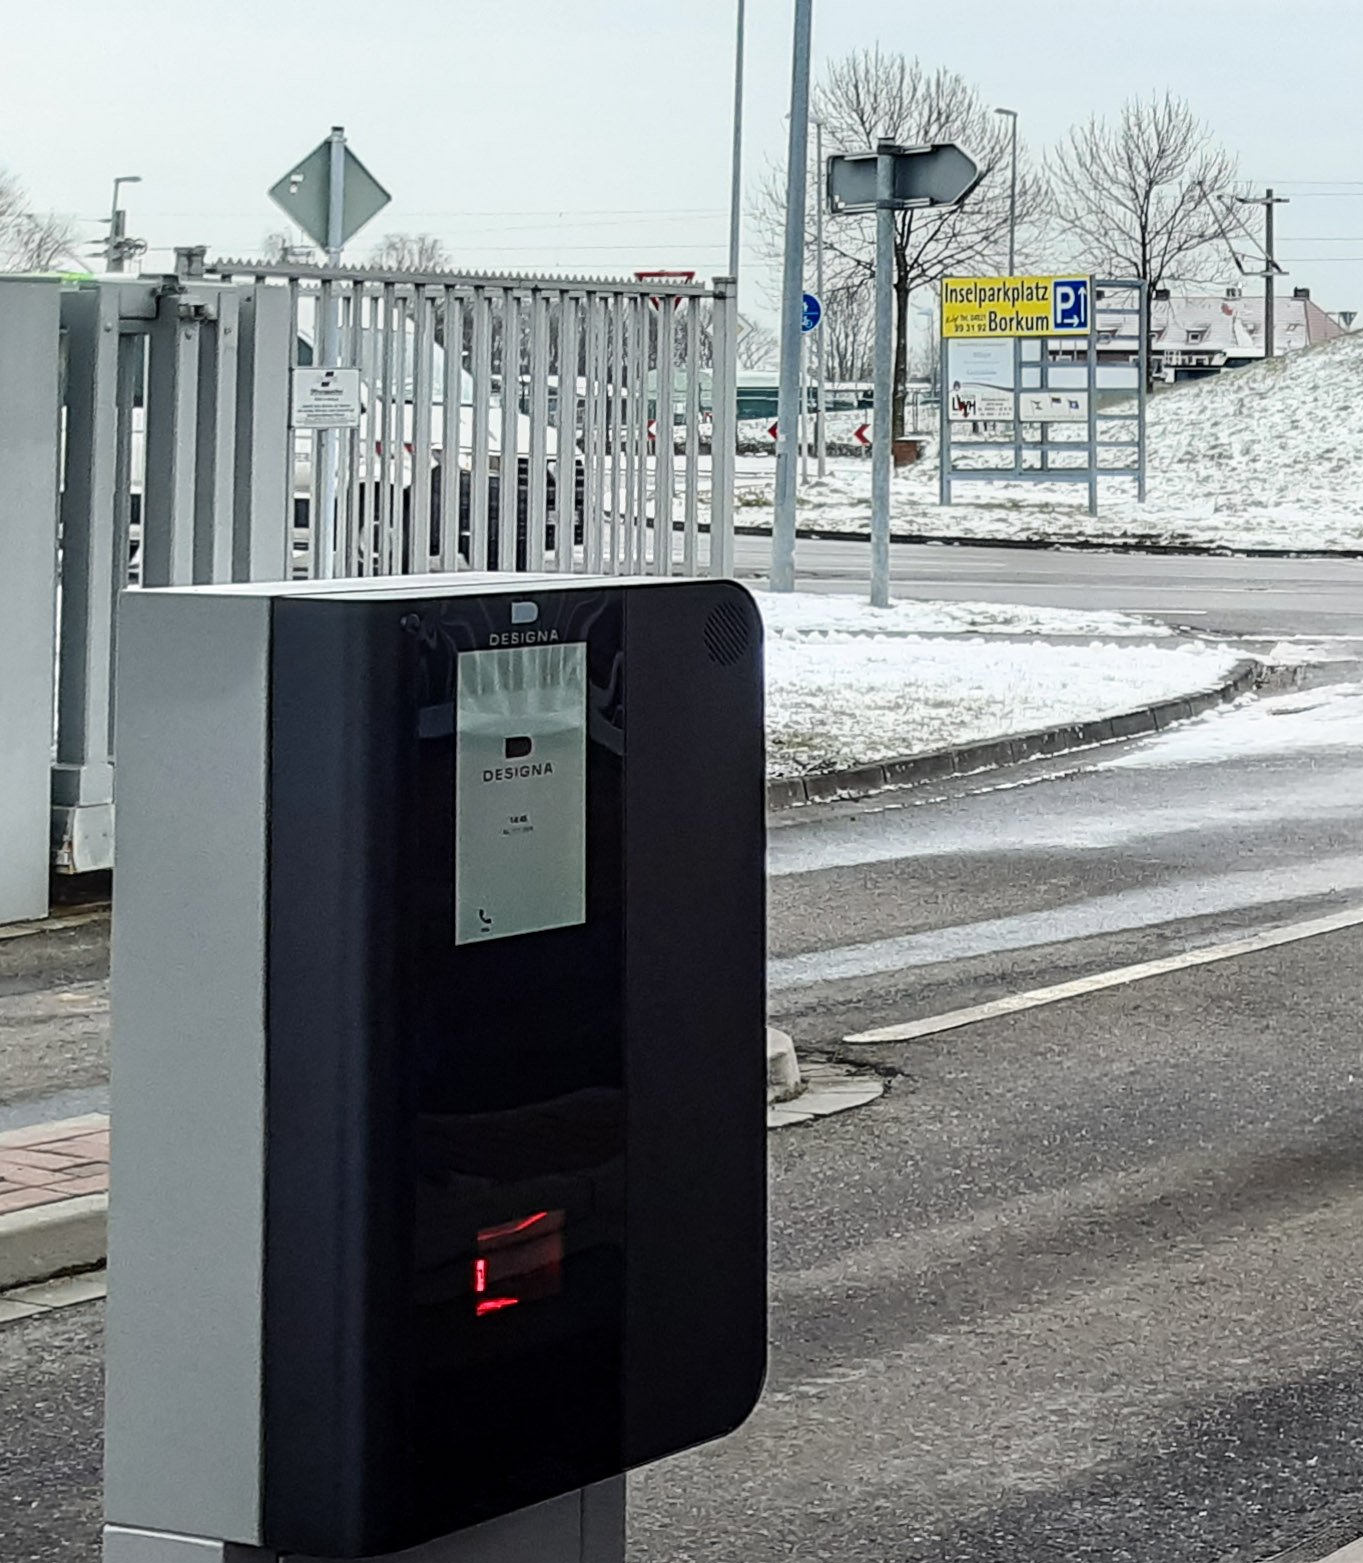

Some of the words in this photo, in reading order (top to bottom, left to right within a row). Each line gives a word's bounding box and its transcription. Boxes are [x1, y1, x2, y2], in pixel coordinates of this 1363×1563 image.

[944, 282, 1049, 308] Inselparkplatz
[1056, 285, 1076, 324] P
[988, 311, 1050, 332] Borkum
[488, 629, 560, 646] DESIGNA
[482, 762, 554, 782] DESIGNA
